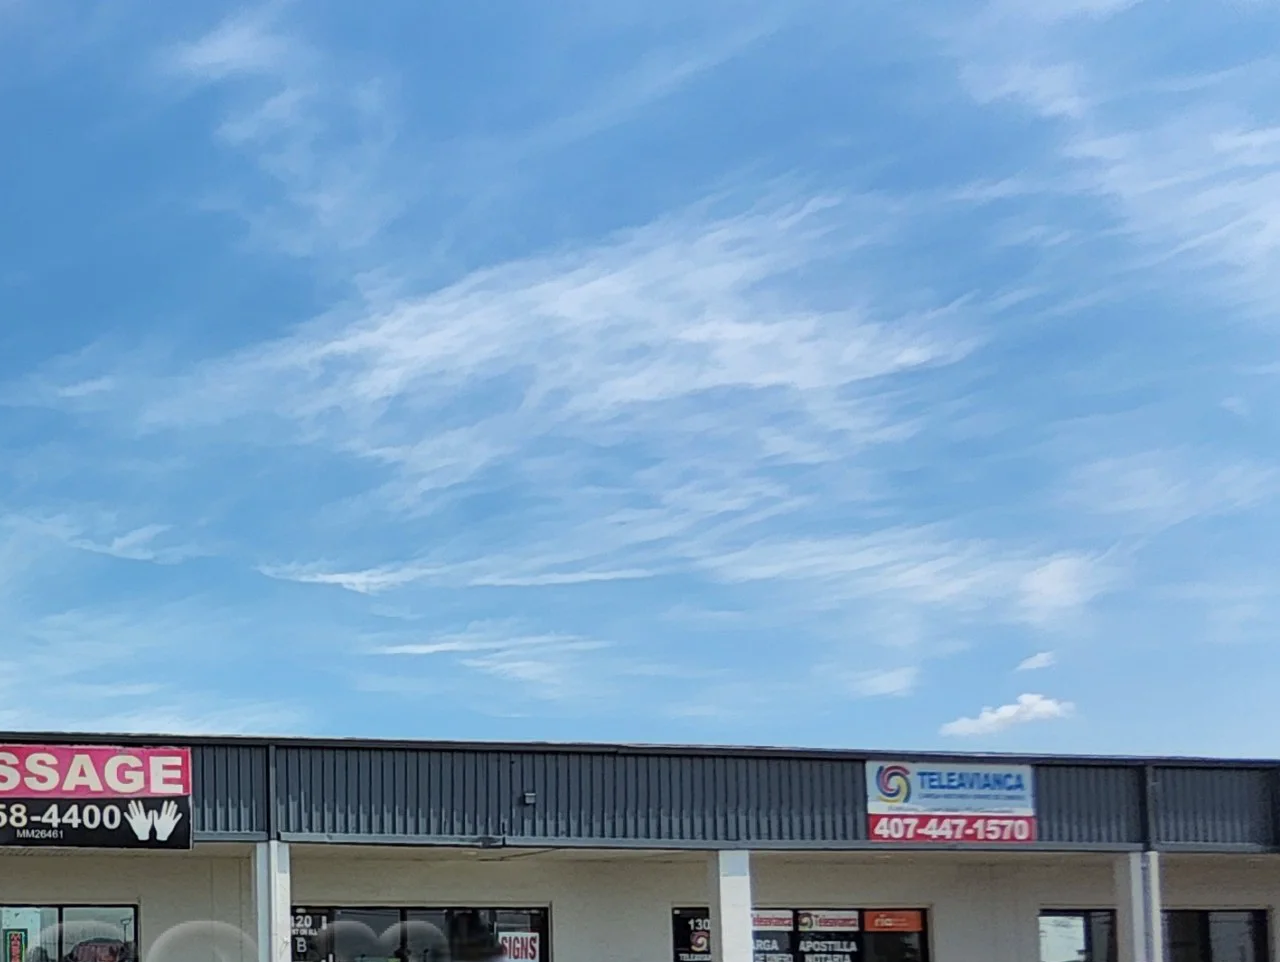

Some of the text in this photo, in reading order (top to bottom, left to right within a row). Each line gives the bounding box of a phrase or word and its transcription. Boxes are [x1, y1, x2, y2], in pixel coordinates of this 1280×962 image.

[916, 771, 1026, 792] TELEAVIANCA
[16, 829, 64, 839] MM26461
[873, 817, 1030, 841] 407-447-1570
[688, 918, 711, 931] 130
[501, 935, 538, 960] SIGNS
[798, 940, 858, 952] APOSTILLA
